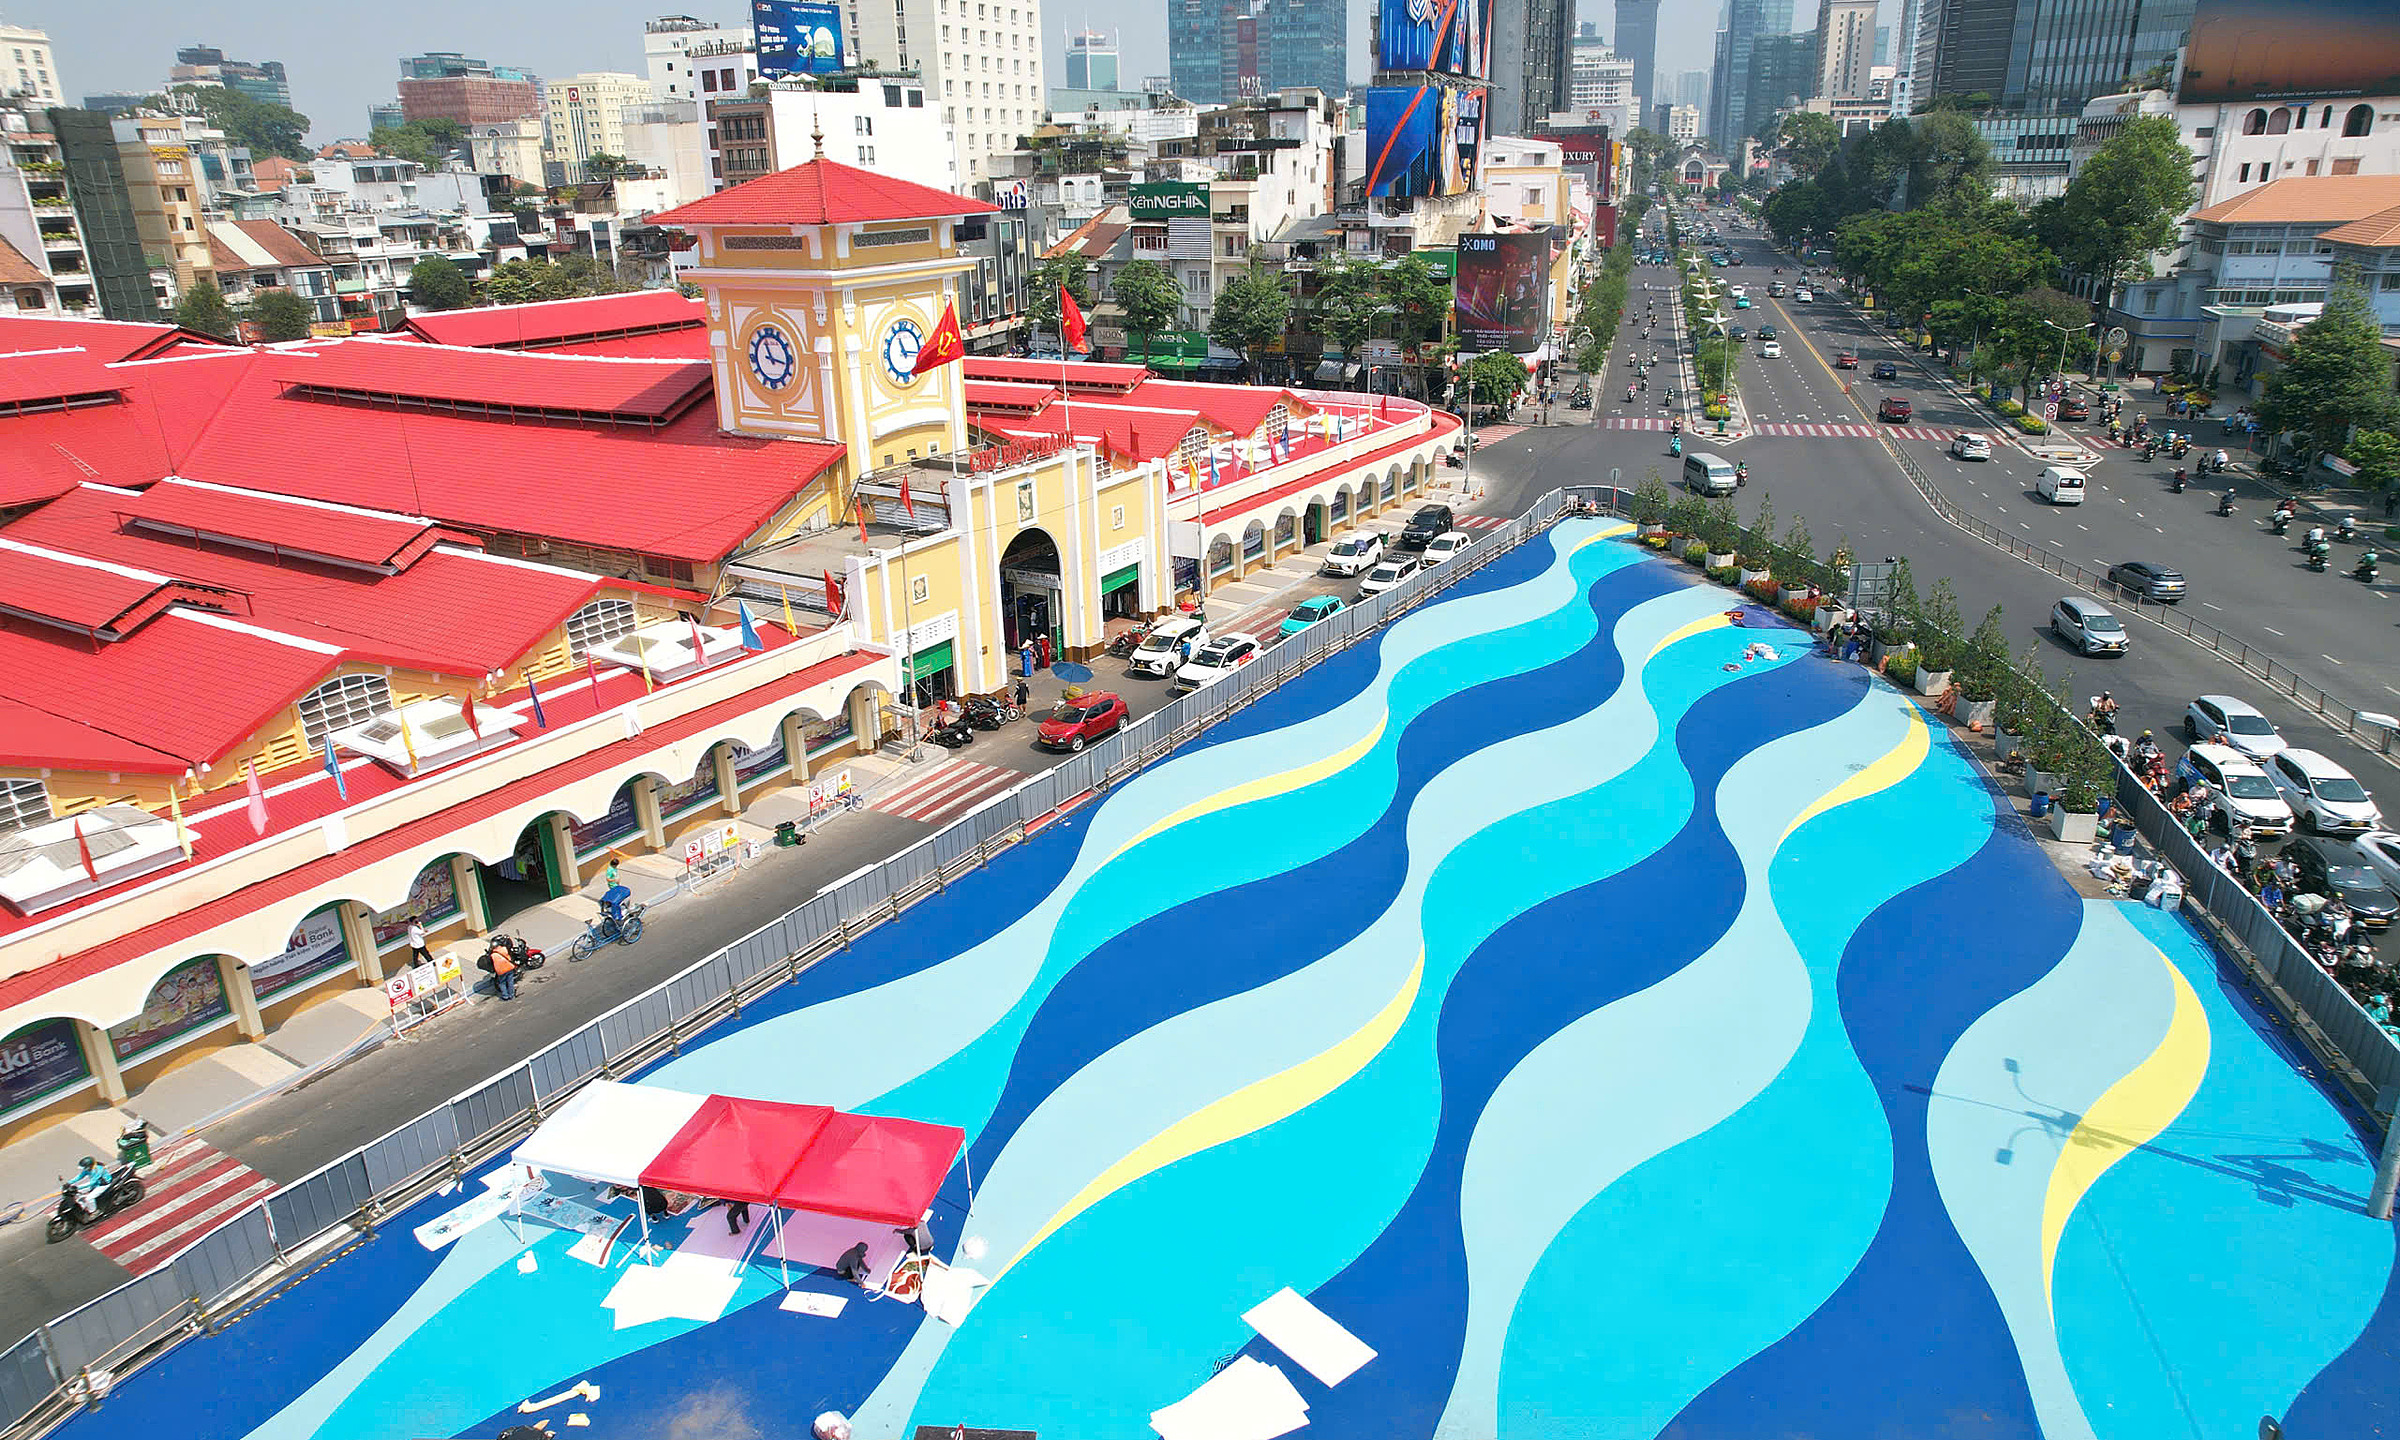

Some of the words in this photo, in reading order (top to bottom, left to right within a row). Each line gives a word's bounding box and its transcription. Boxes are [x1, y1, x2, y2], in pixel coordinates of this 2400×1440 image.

[768, 82, 791, 91] OZONE
[792, 83, 805, 91] BAR
[1563, 151, 1596, 161] UXURY
[610, 800, 629, 814] Bank
[308, 928, 335, 944] Bank
[33, 1040, 68, 1061] Bank
